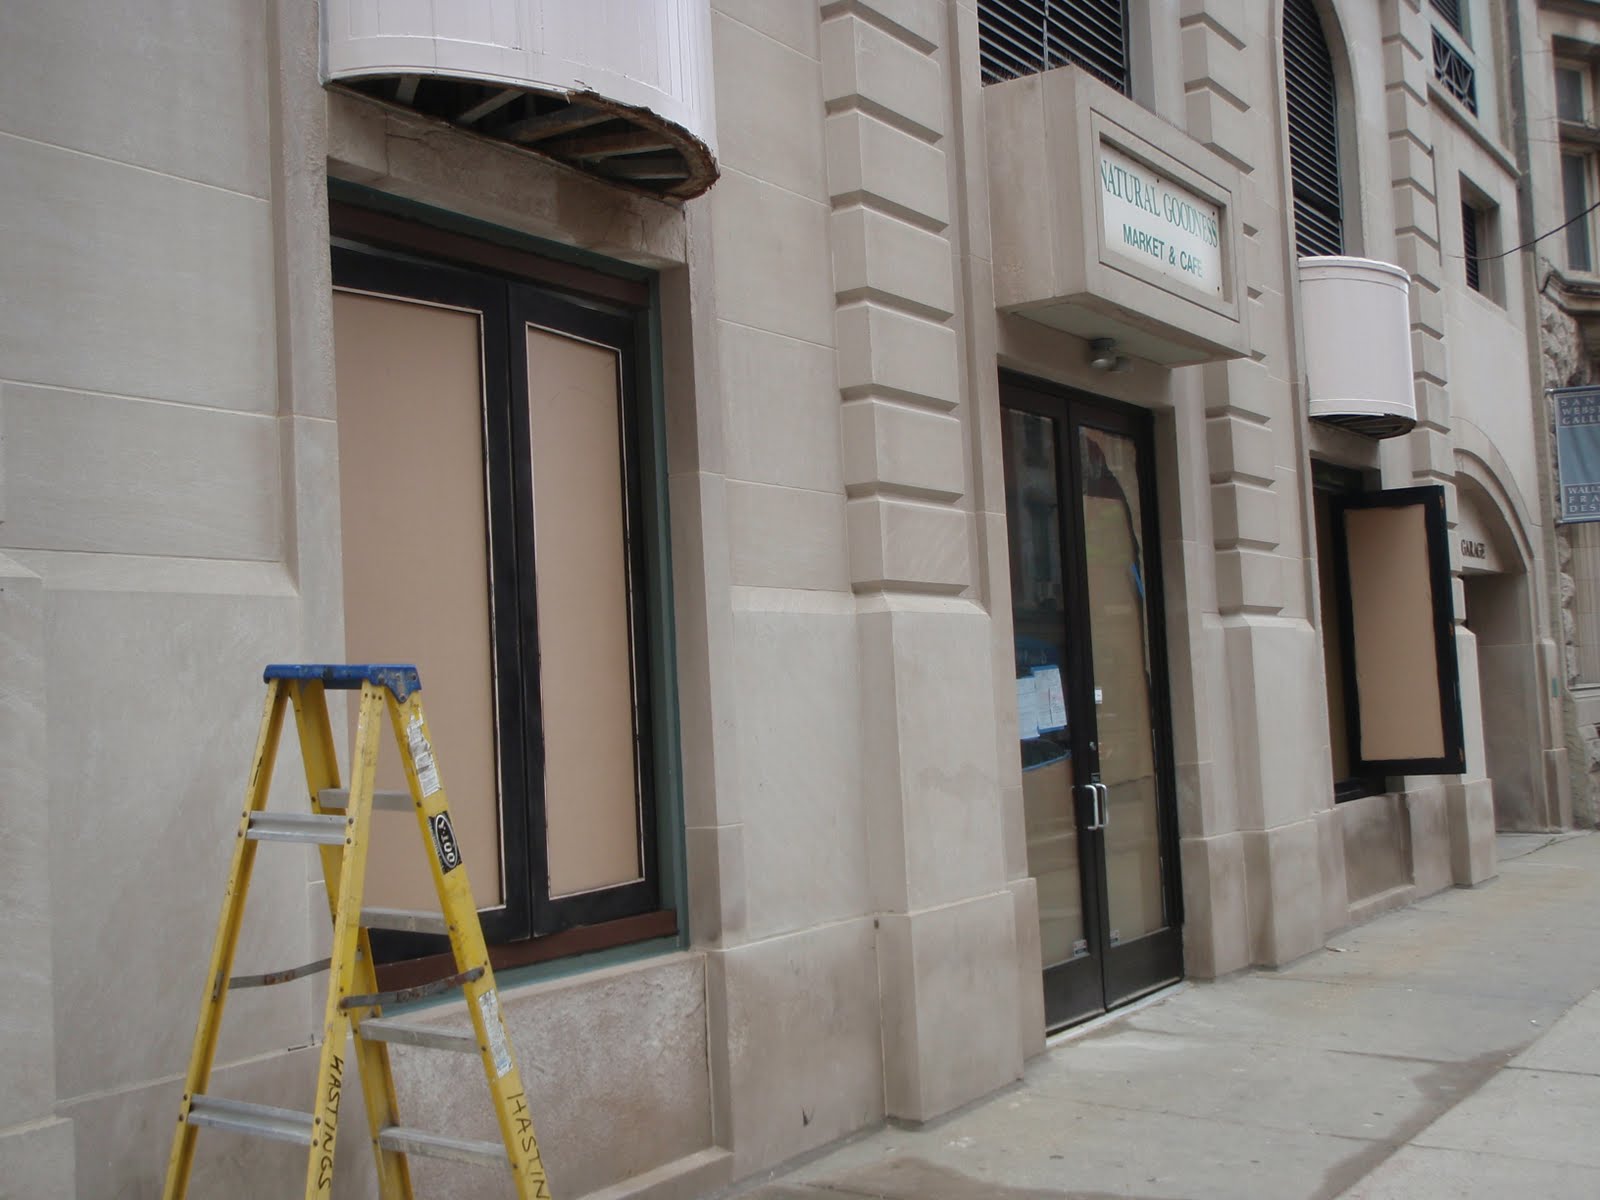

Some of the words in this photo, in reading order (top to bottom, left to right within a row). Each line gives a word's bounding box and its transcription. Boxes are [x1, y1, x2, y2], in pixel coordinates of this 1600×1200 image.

[1100, 160, 1161, 217] NATURAL
[1163, 193, 1218, 248] GOODNESS
[1122, 223, 1165, 261] MARKET
[1168, 246, 1176, 266] &
[1179, 250, 1204, 278] CAFE
[317, 1054, 344, 1191] HASTINGS
[506, 1092, 551, 1199] HASTIN
